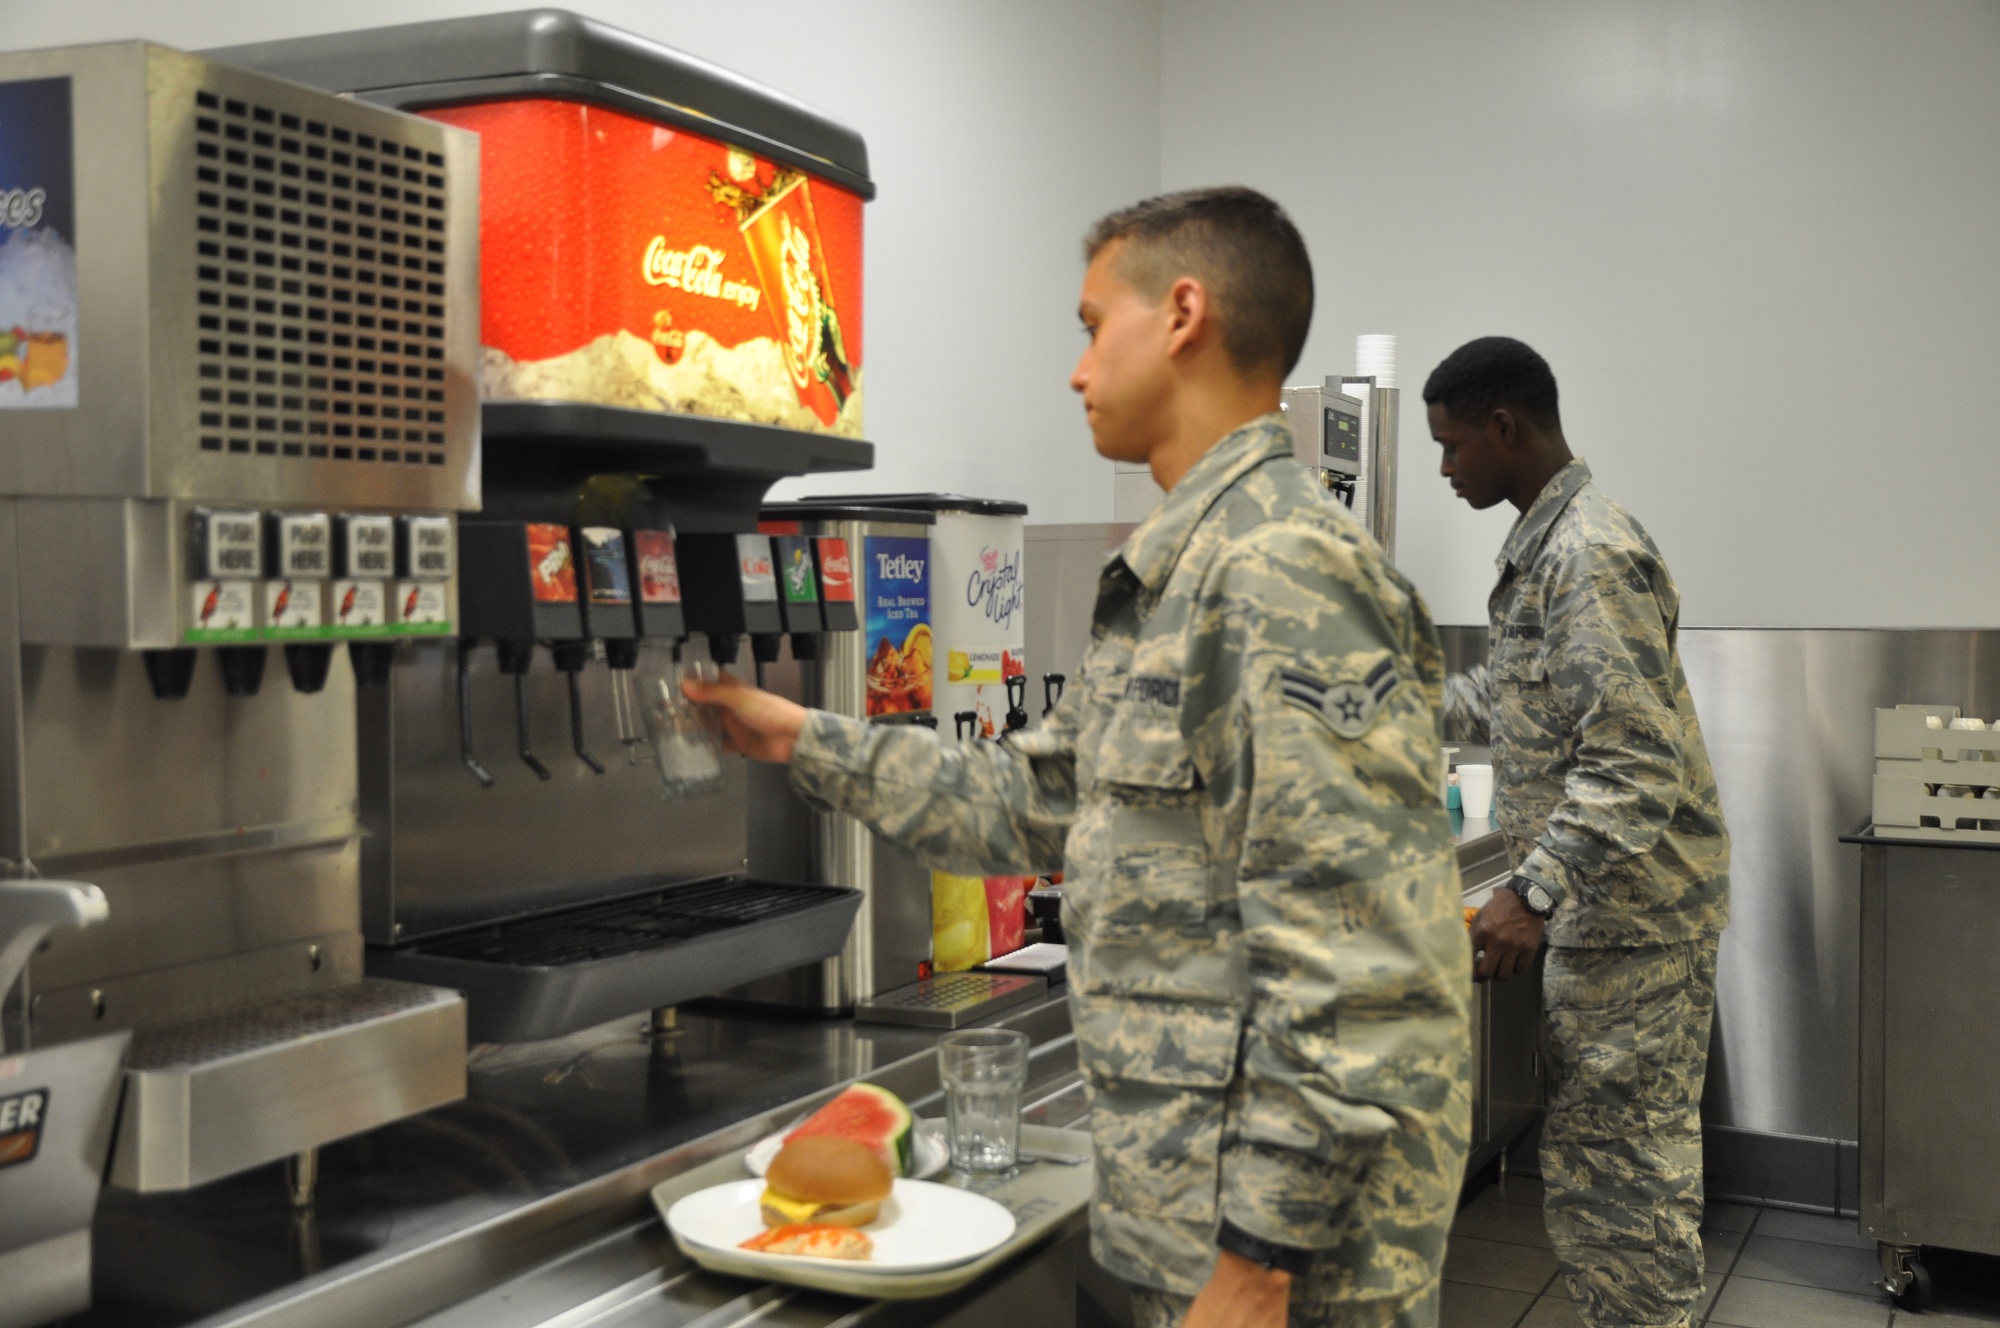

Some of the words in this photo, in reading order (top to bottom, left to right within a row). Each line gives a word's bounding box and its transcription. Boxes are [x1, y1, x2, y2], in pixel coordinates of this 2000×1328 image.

[721, 278, 761, 312] enjoy
[876, 553, 925, 584] Tetley
[967, 550, 1020, 618] Crystal
